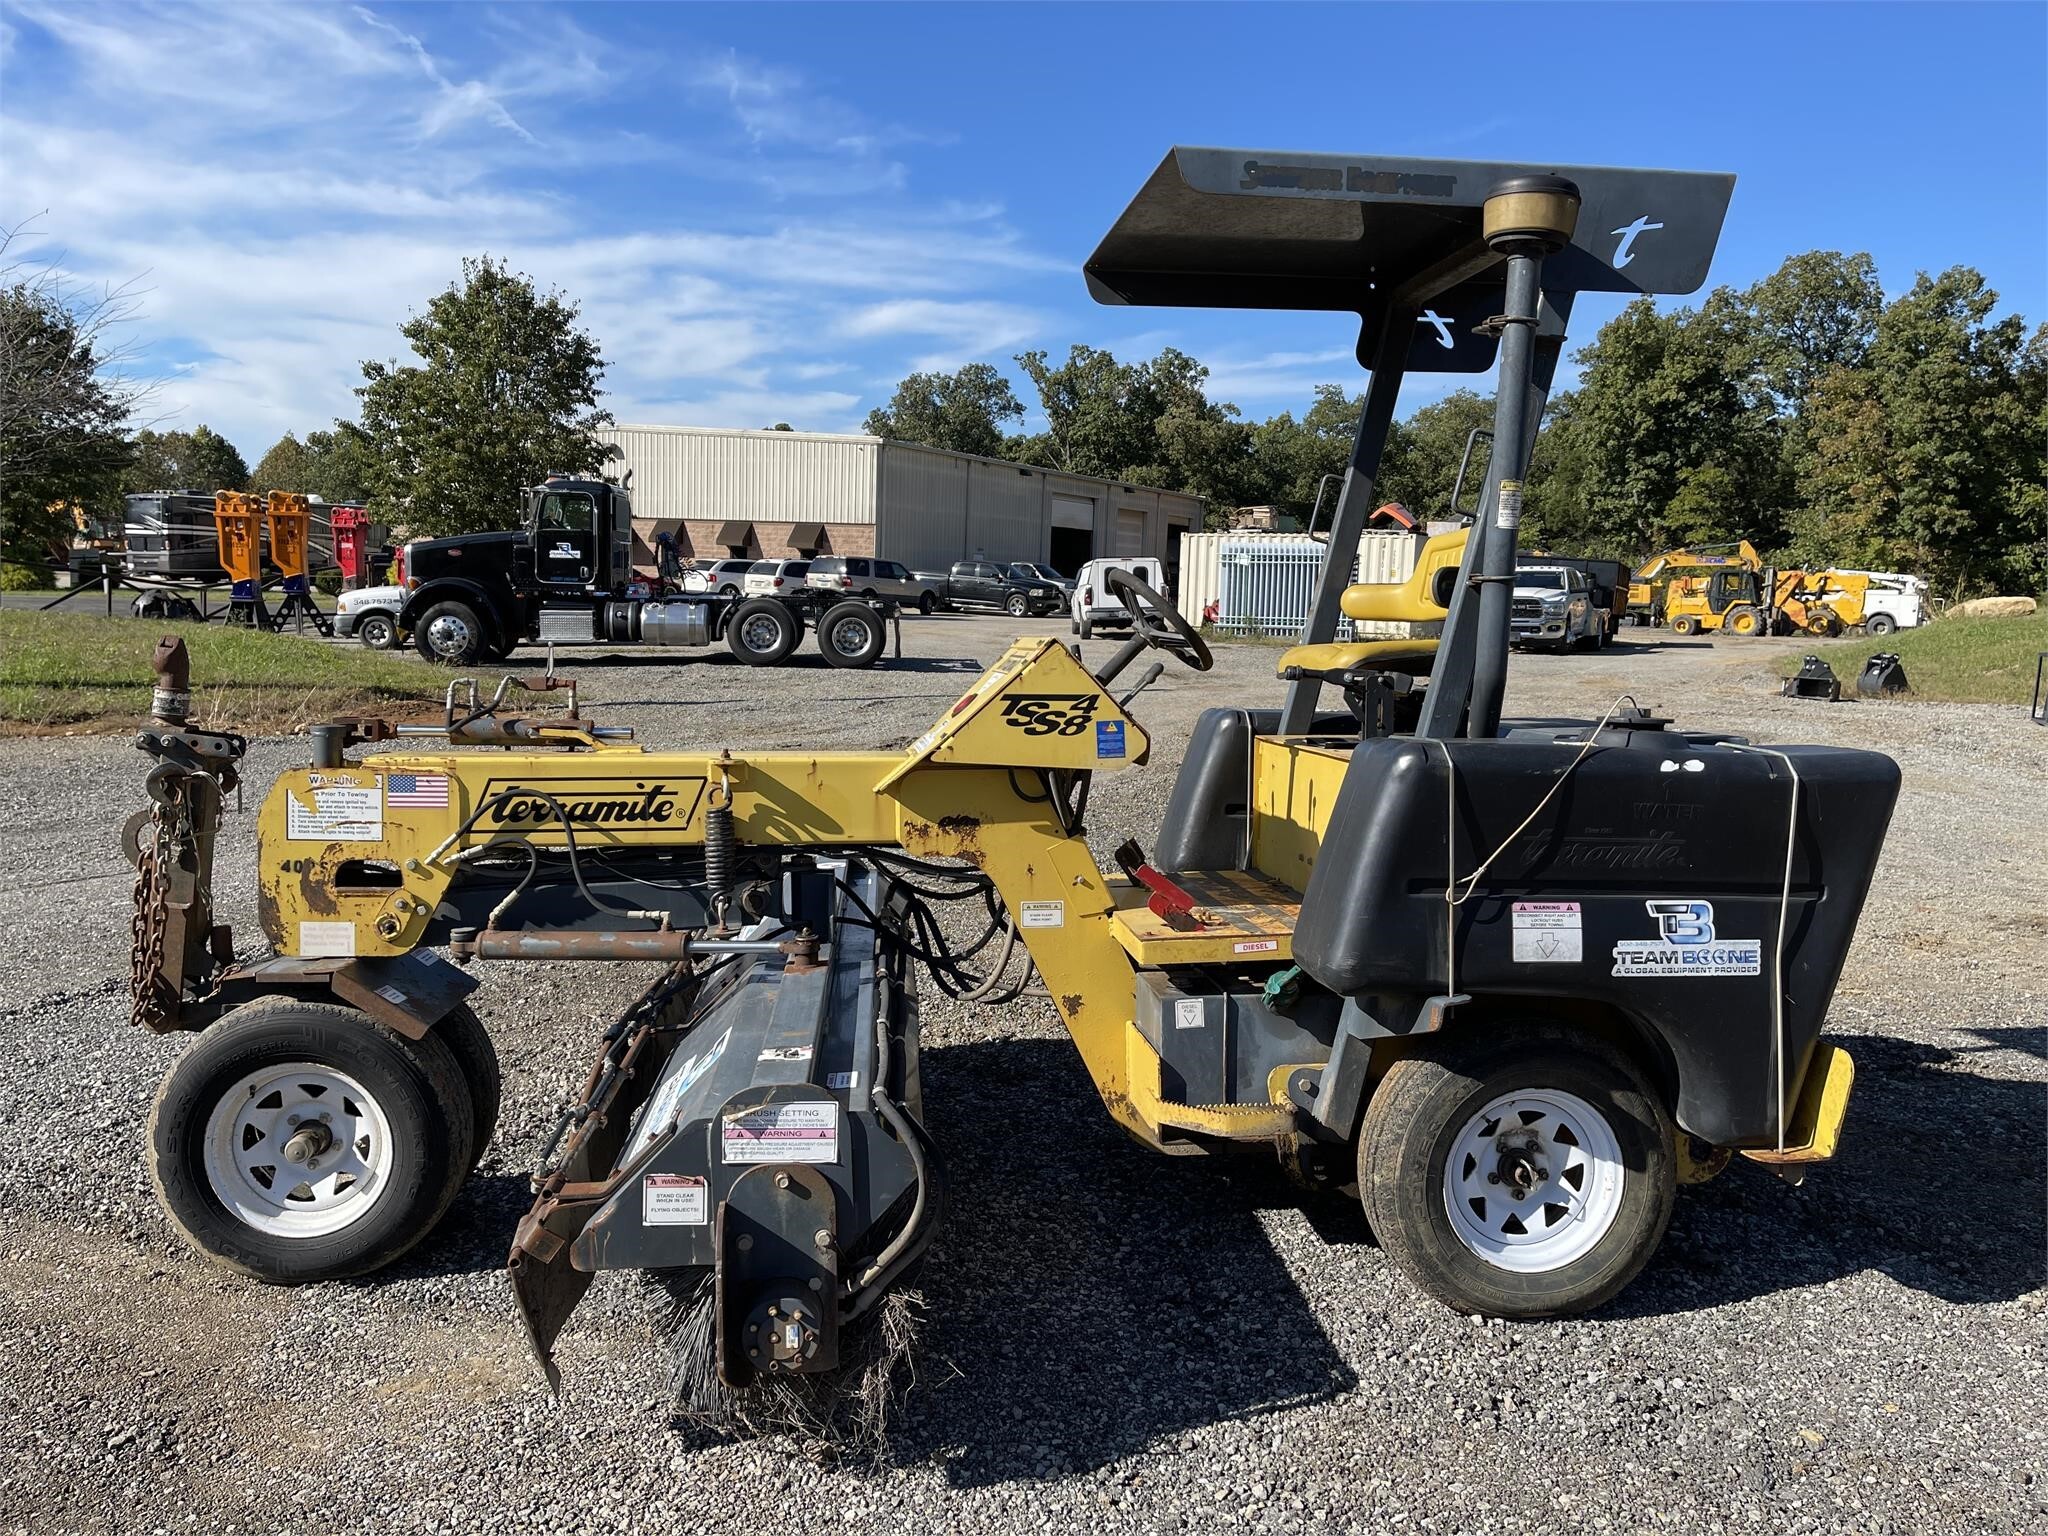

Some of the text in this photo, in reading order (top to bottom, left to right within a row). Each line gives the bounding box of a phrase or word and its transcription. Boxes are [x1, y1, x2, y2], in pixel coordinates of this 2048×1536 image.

[347, 791, 369, 799] Towing
[1242, 943, 1269, 951] DIESEL
[1617, 949, 1759, 965] TEAM BOONE
[1714, 966, 1759, 974] PROVIDER
[778, 1109, 819, 1117] SETTING
